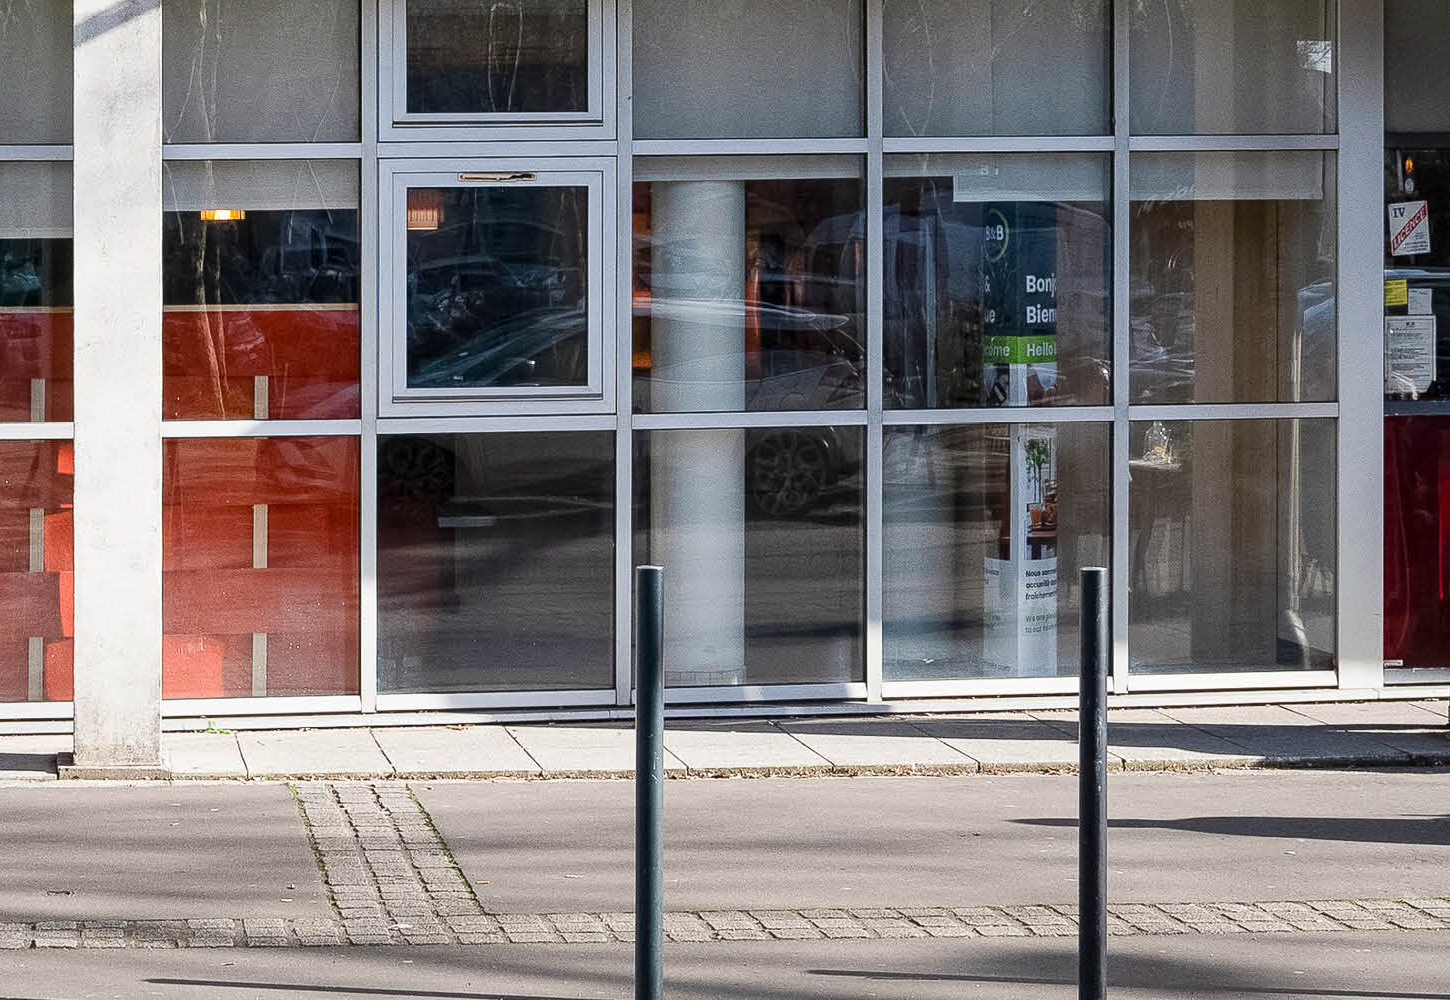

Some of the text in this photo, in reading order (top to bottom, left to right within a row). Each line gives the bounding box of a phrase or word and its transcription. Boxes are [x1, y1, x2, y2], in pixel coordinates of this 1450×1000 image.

[1393, 207, 1406, 218] IV
[985, 225, 1005, 241] B&B
[1393, 206, 1427, 250] LICENCE
